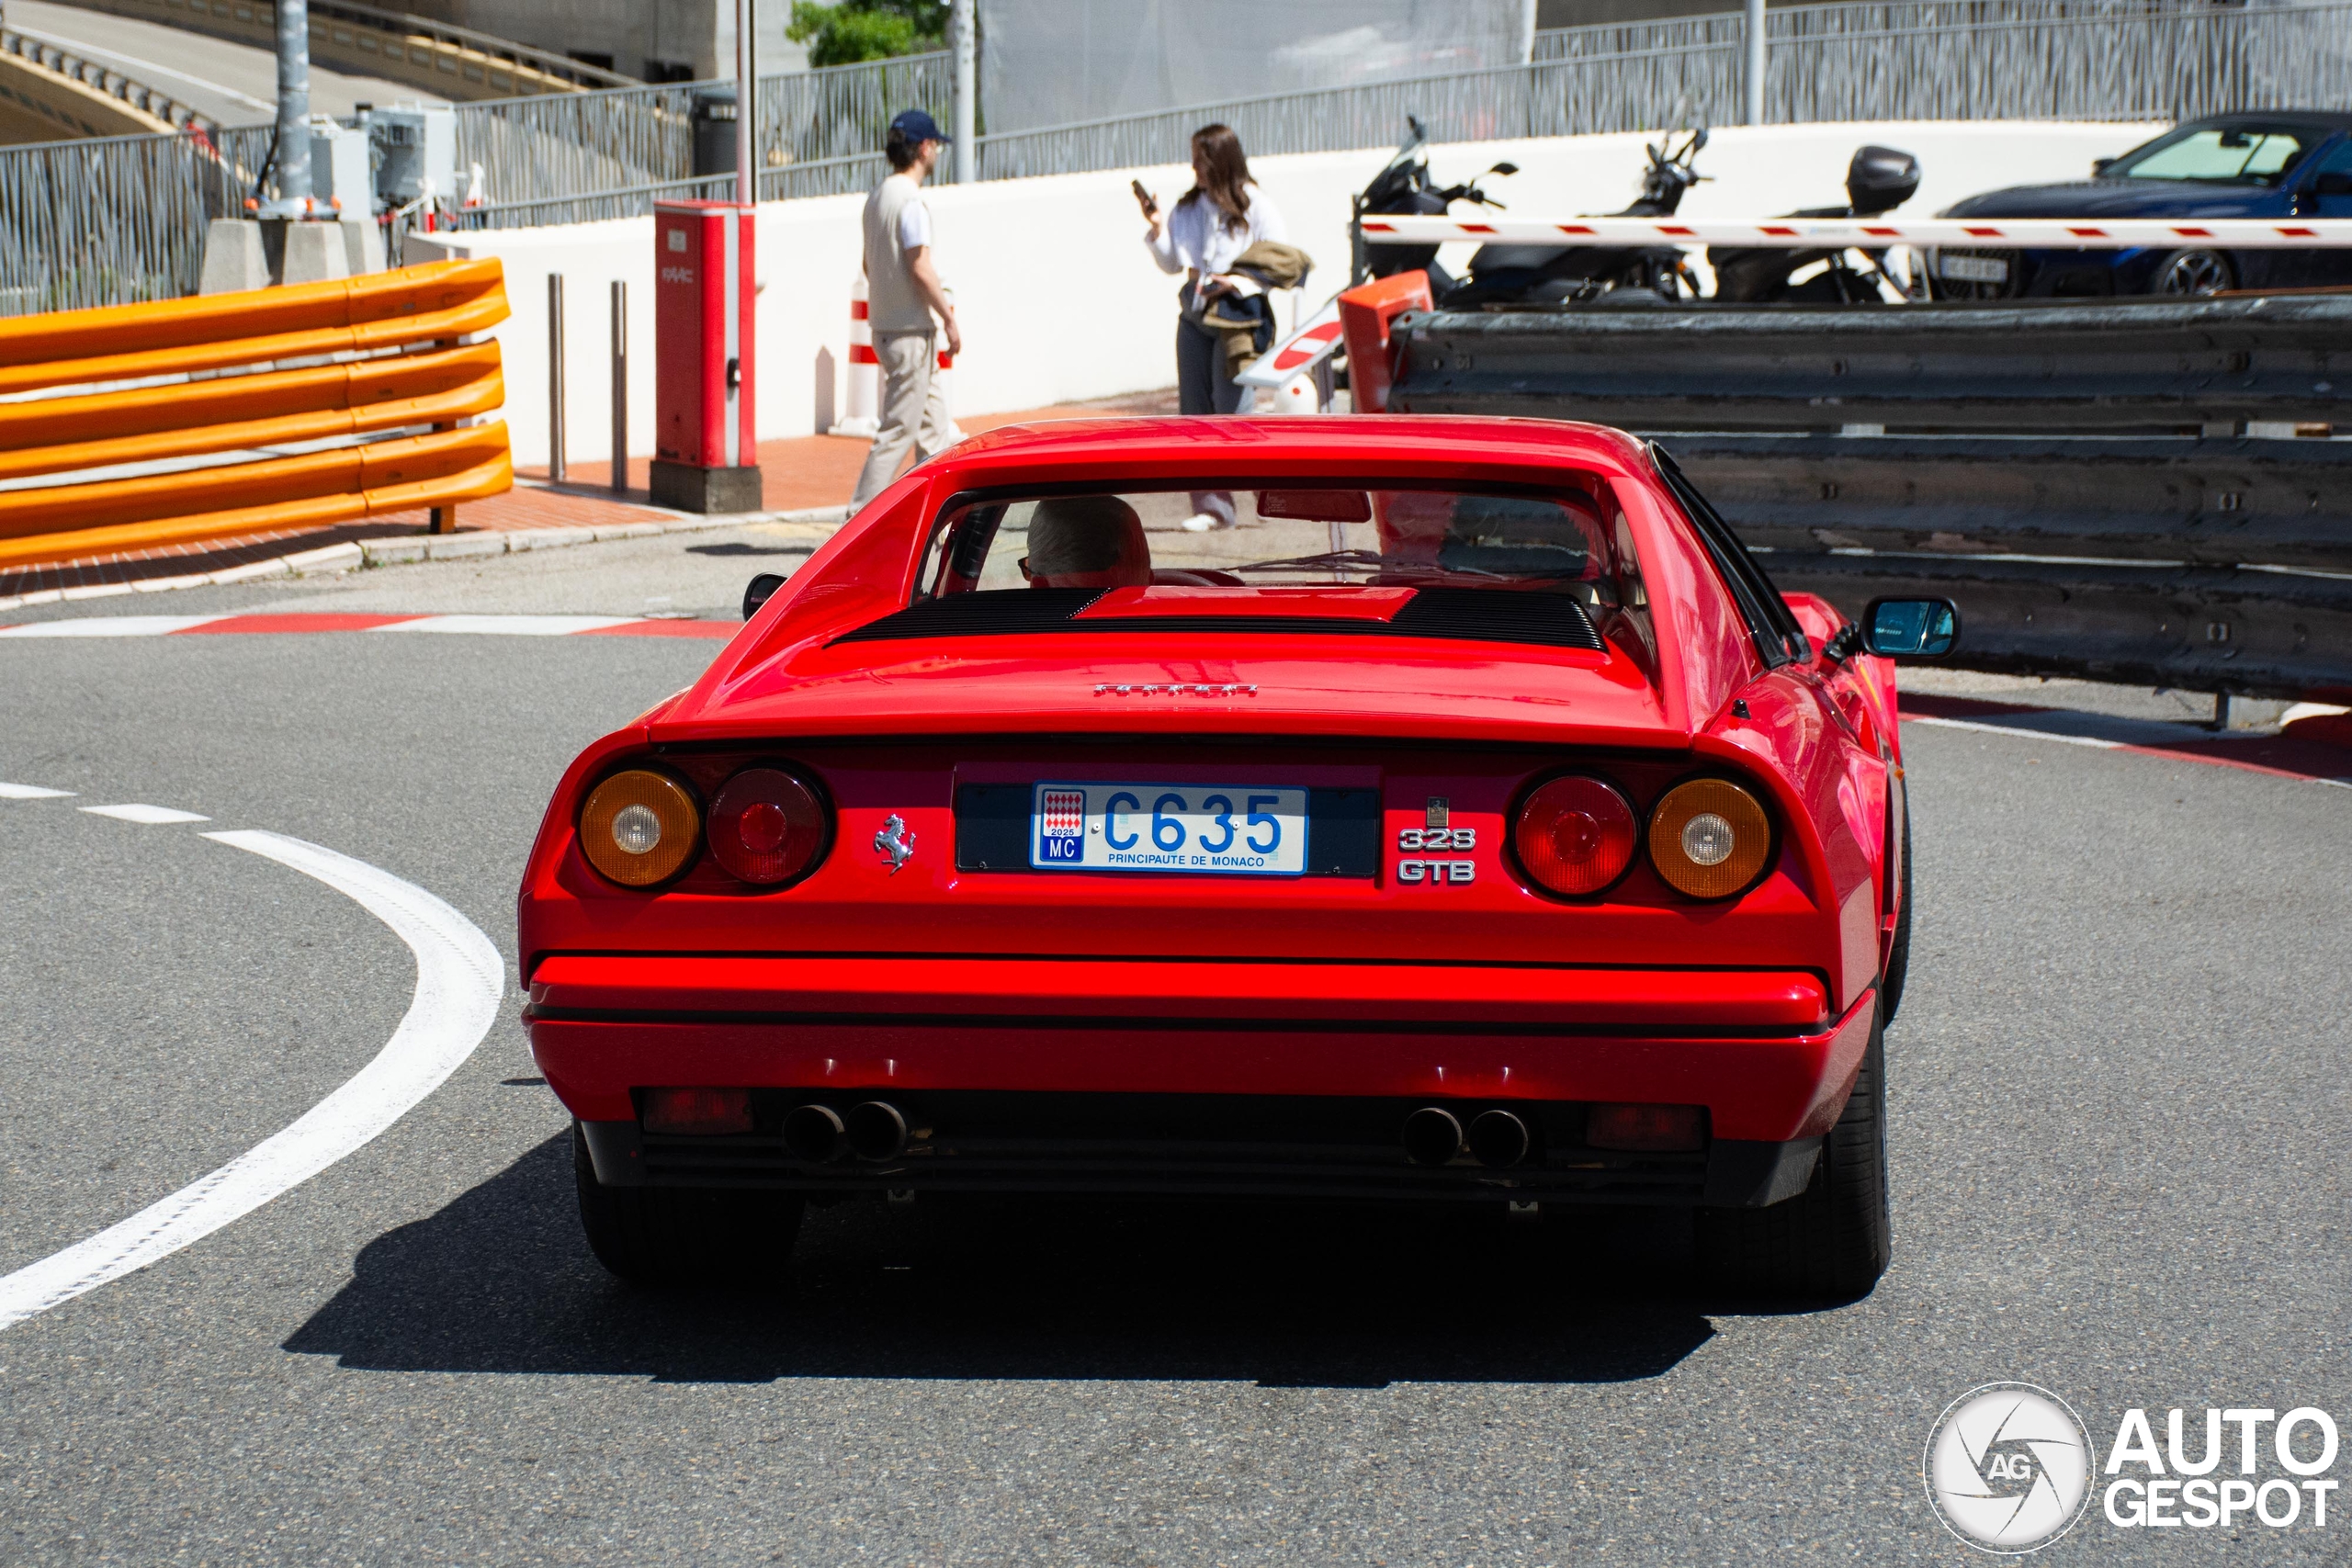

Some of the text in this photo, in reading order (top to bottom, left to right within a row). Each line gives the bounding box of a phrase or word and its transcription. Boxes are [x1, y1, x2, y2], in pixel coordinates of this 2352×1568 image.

[1104, 792, 1282, 854] C635
[1049, 839, 1075, 858] MC
[1399, 828, 1476, 851] 328
[1108, 853, 1265, 867] PRINCIPAUTE DE MONACO
[1398, 859, 1476, 881] GTB
